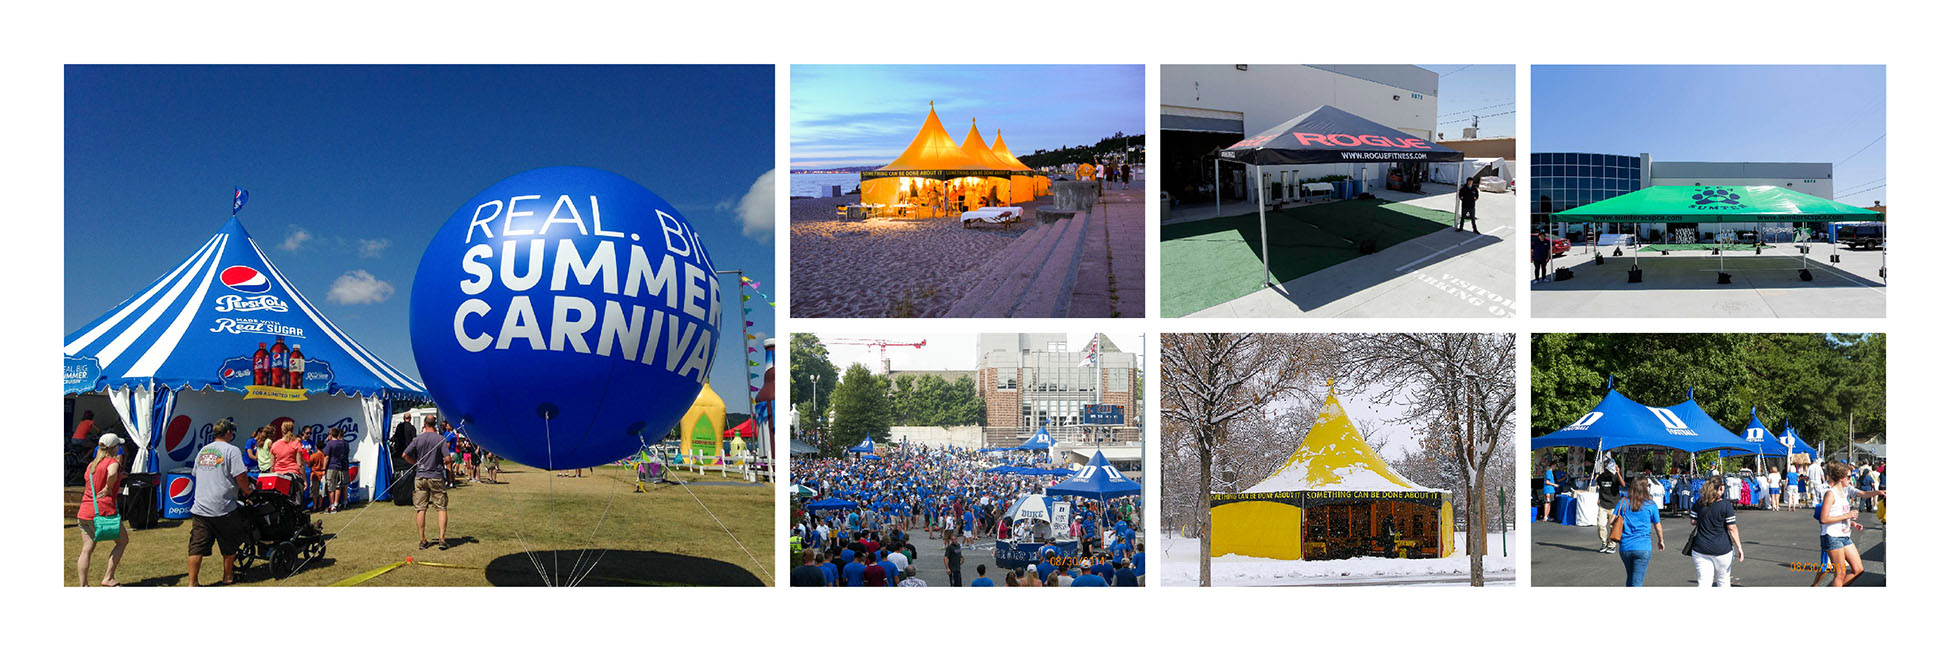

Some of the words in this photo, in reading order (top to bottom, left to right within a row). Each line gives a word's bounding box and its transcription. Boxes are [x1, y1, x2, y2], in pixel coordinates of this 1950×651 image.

[1293, 132, 1431, 149] ROGUE
[1341, 151, 1427, 160] WWW.ROGUEFITNESS.COM
[465, 194, 641, 243] REAL.
[460, 238, 722, 332] SUMMER
[266, 324, 304, 336] SUGAR
[1665, 428, 1699, 436] FOOTBALL
[1274, 491, 1294, 499] ABOUT
[1306, 491, 1351, 500] SOMETHING
[1354, 490, 1369, 498] CAN
[1382, 491, 1402, 499] DONE
[1404, 491, 1429, 499] ABOUT
[168, 507, 191, 516] peps
[1021, 510, 1044, 518] DUKE
